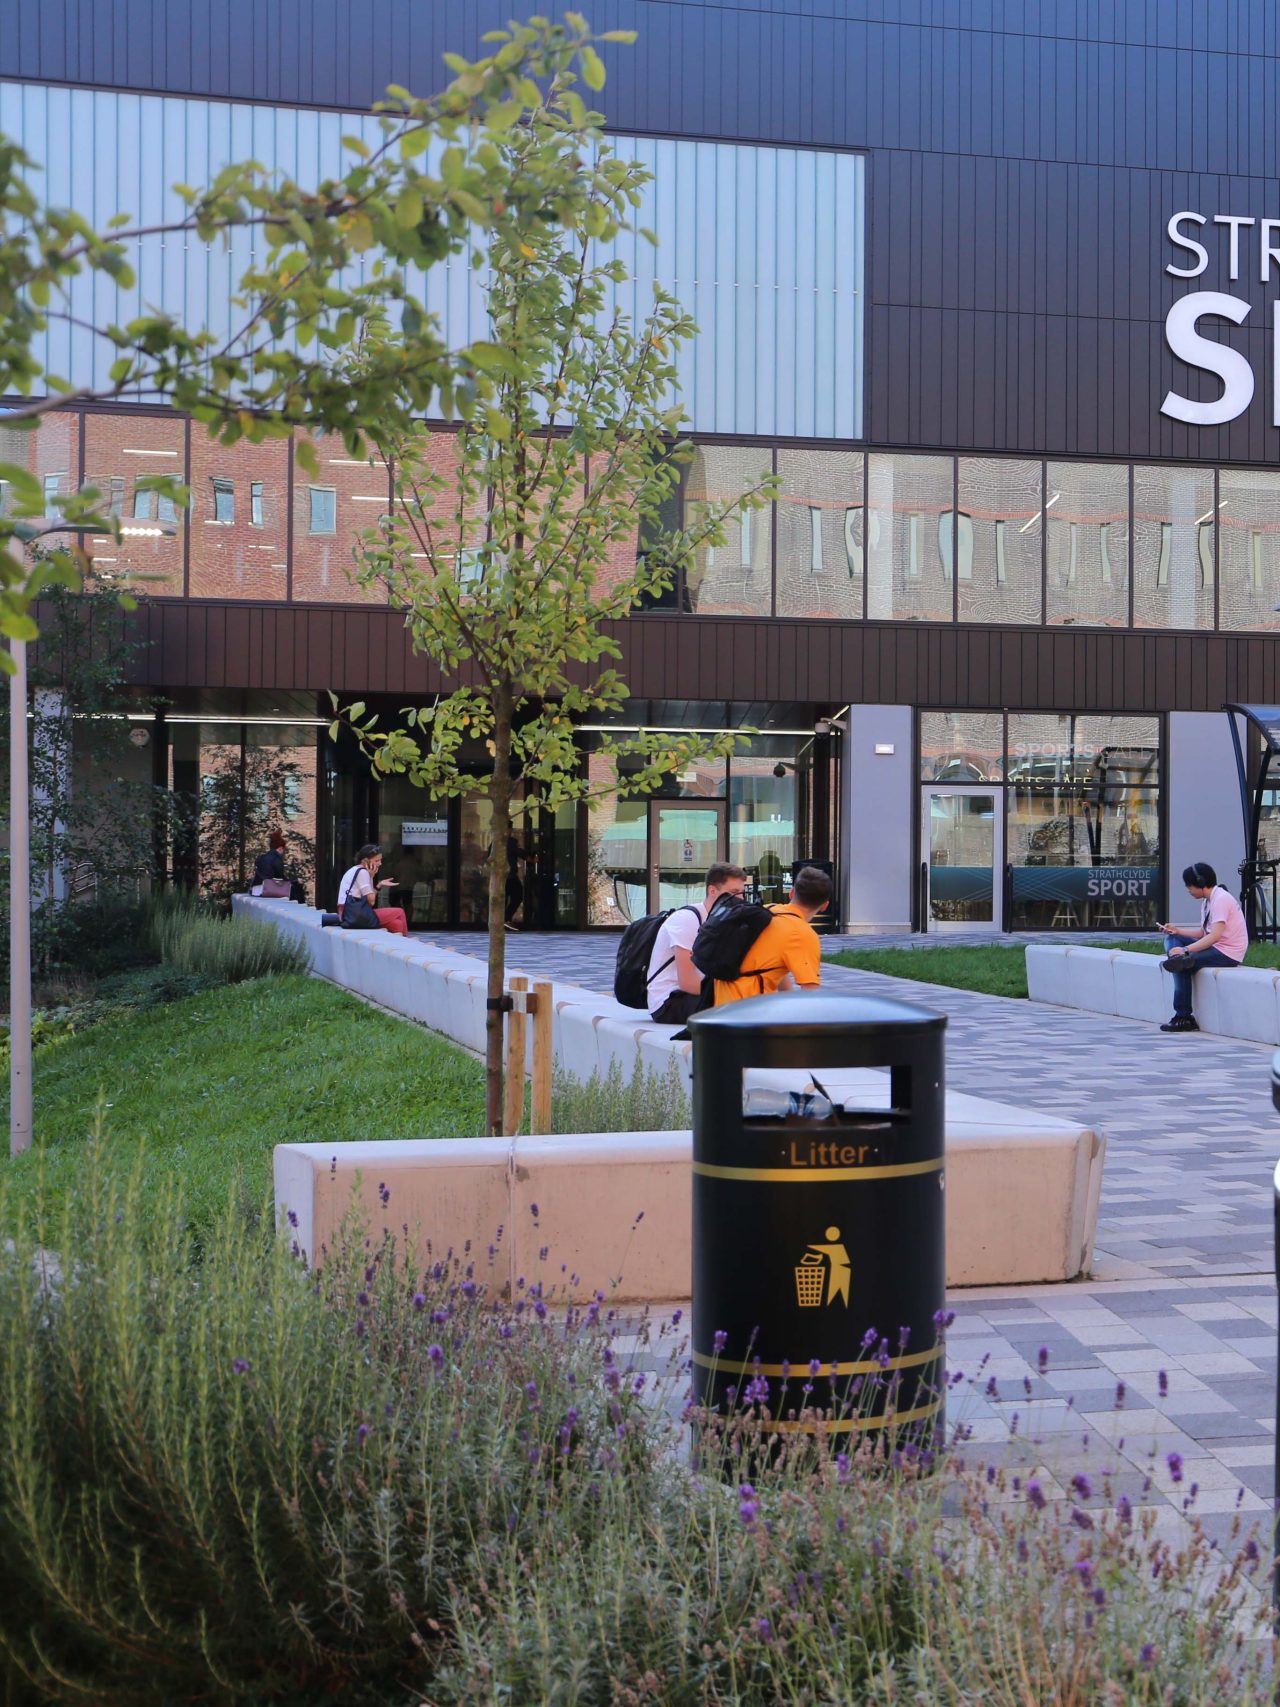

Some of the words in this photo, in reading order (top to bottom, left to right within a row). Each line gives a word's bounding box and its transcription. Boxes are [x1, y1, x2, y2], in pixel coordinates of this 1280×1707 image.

[1015, 743, 1095, 759] SPORTS
[1088, 869, 1151, 879] STRATHCLYDE
[1087, 879, 1151, 897] SPORT
[790, 1141, 869, 1166] Litter
